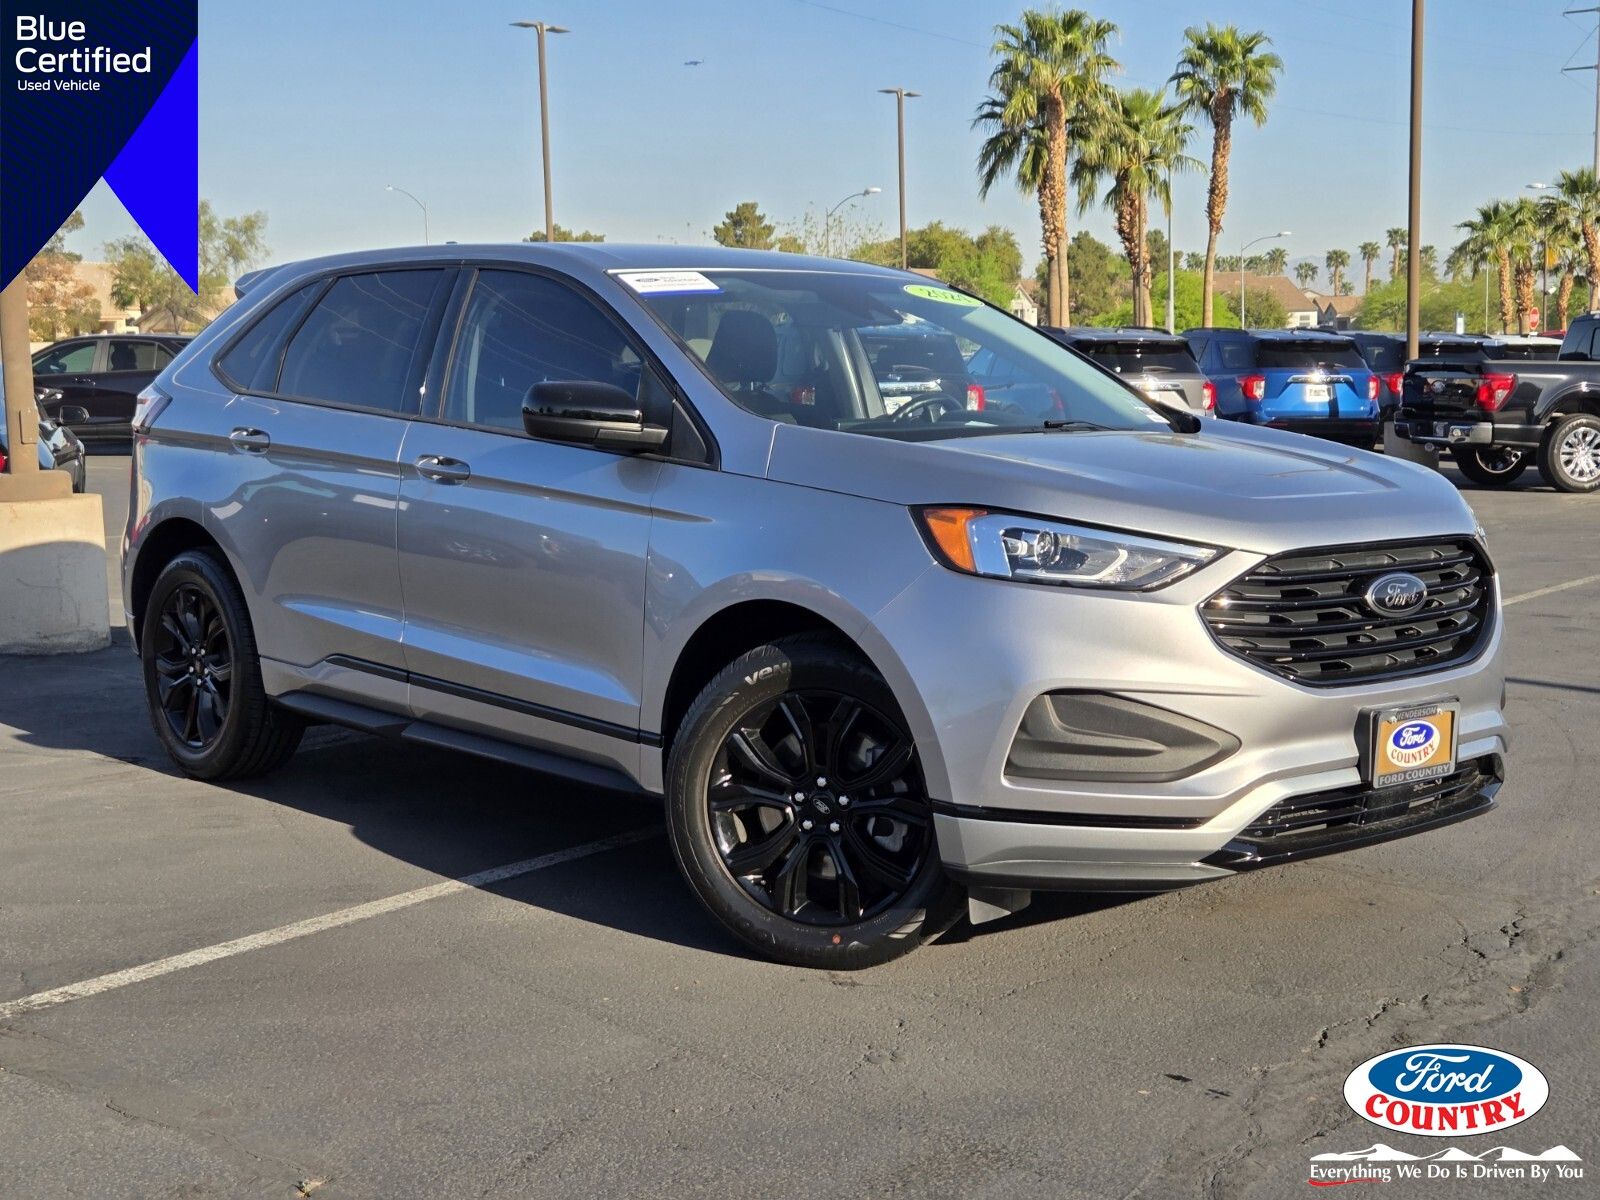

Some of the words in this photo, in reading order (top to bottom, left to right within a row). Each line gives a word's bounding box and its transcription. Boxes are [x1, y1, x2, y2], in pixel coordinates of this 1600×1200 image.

[1385, 582, 1419, 607] Ford
[1400, 726, 1427, 747] Ford
[1391, 741, 1435, 764] COUNTRY
[1379, 773, 1405, 785] FORD
[1406, 764, 1450, 780] COUNTRY
